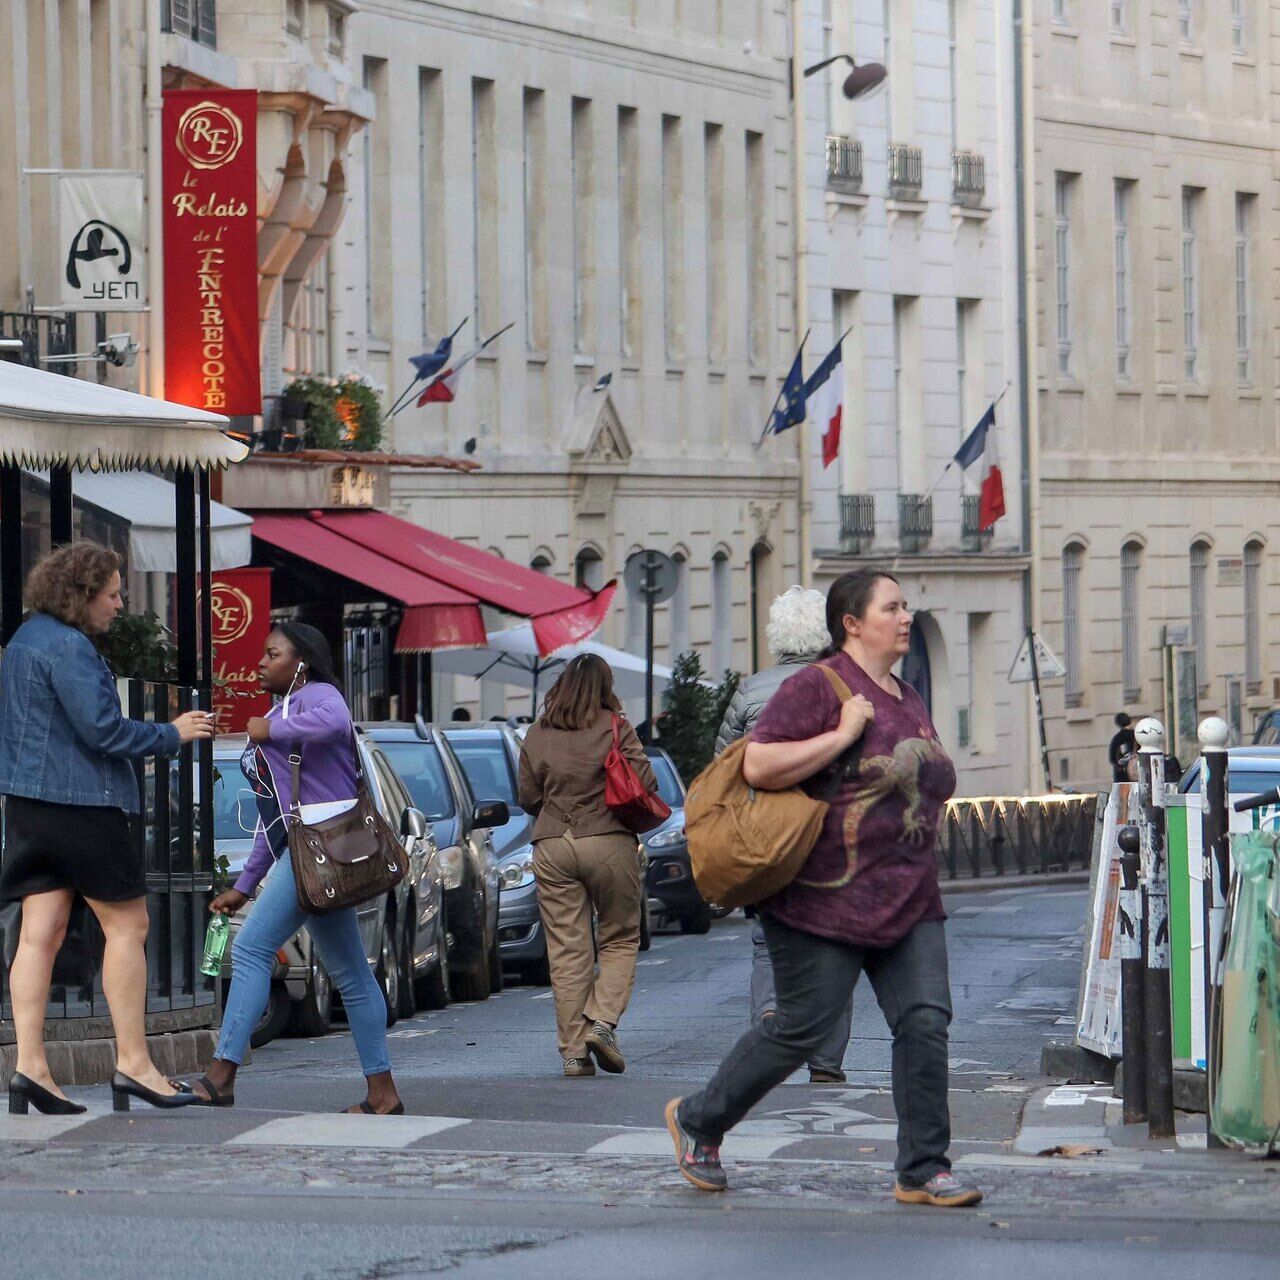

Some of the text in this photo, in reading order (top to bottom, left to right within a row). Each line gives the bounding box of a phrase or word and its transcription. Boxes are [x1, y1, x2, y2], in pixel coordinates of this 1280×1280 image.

[182, 170, 199, 188] le
[172, 191, 249, 218] Relais
[193, 227, 211, 243] de
[196, 248, 227, 410] ENTRECOTE
